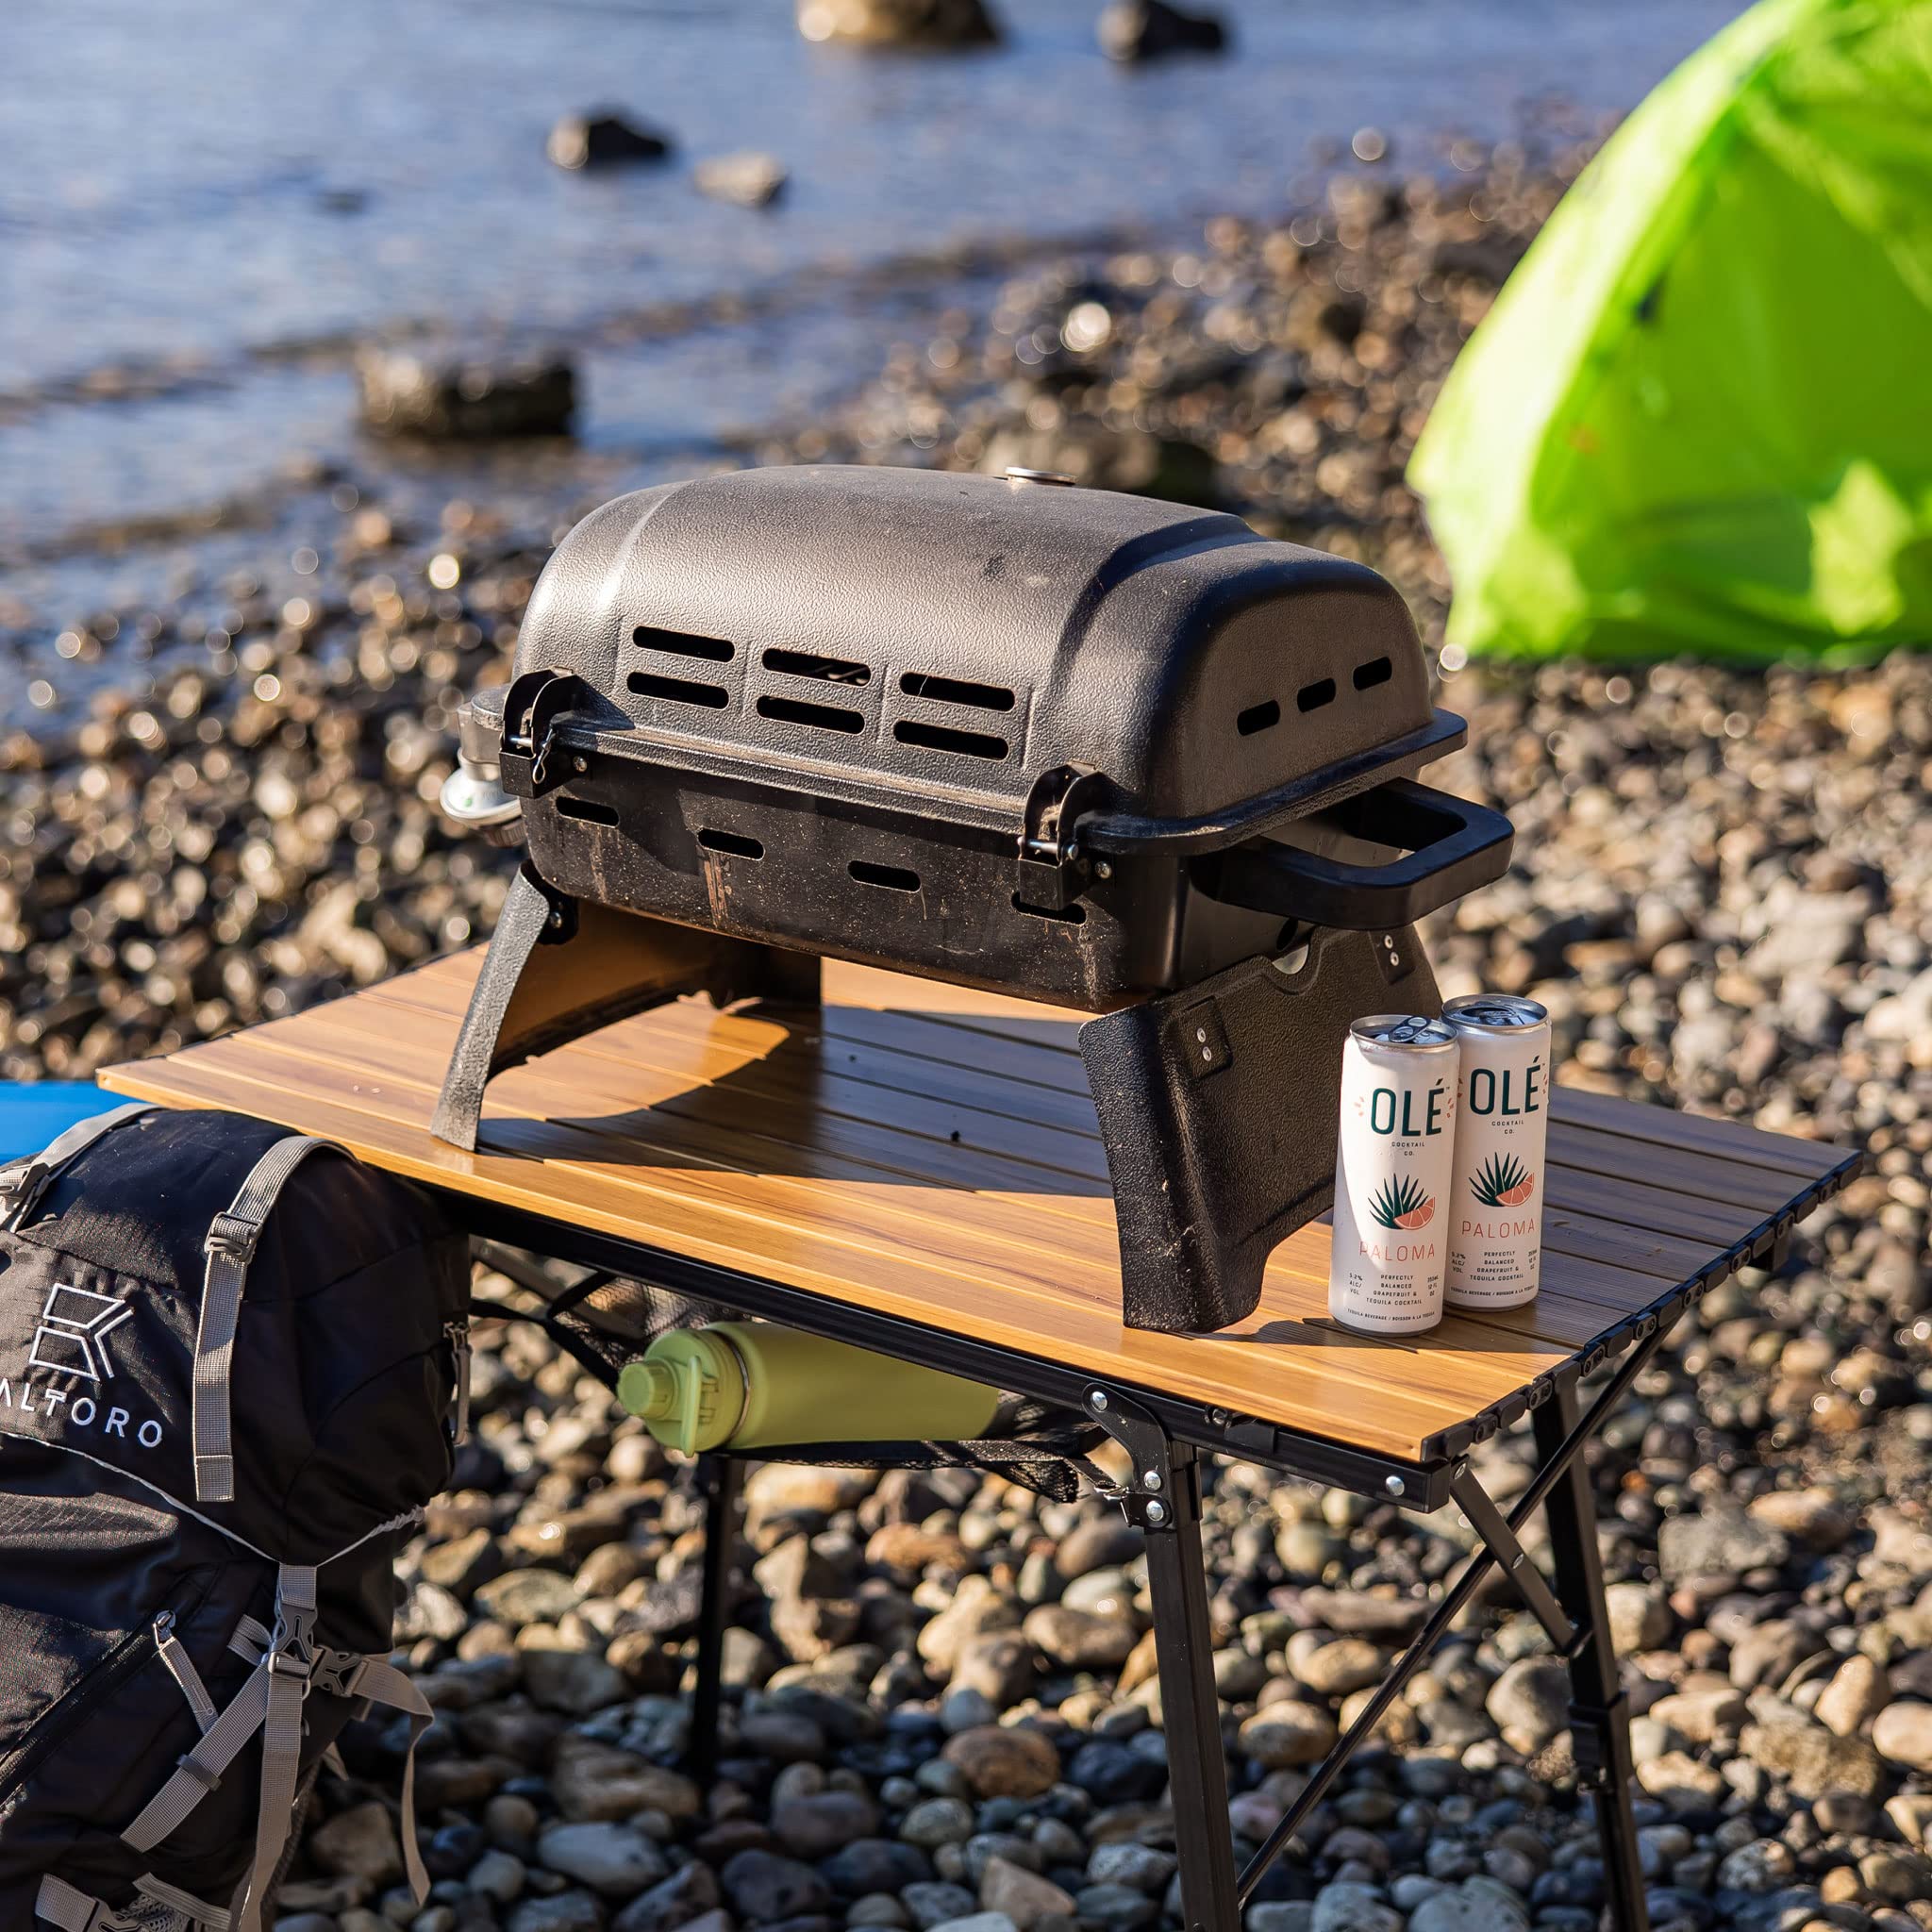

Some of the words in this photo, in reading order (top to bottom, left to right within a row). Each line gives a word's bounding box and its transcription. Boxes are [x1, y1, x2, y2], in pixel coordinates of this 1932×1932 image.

[1469, 1055, 1541, 1116] OLÉ
[1371, 1077, 1444, 1137] OLÉ
[1461, 1218, 1535, 1239] PALOMA
[1359, 1241, 1435, 1262] PALOMA
